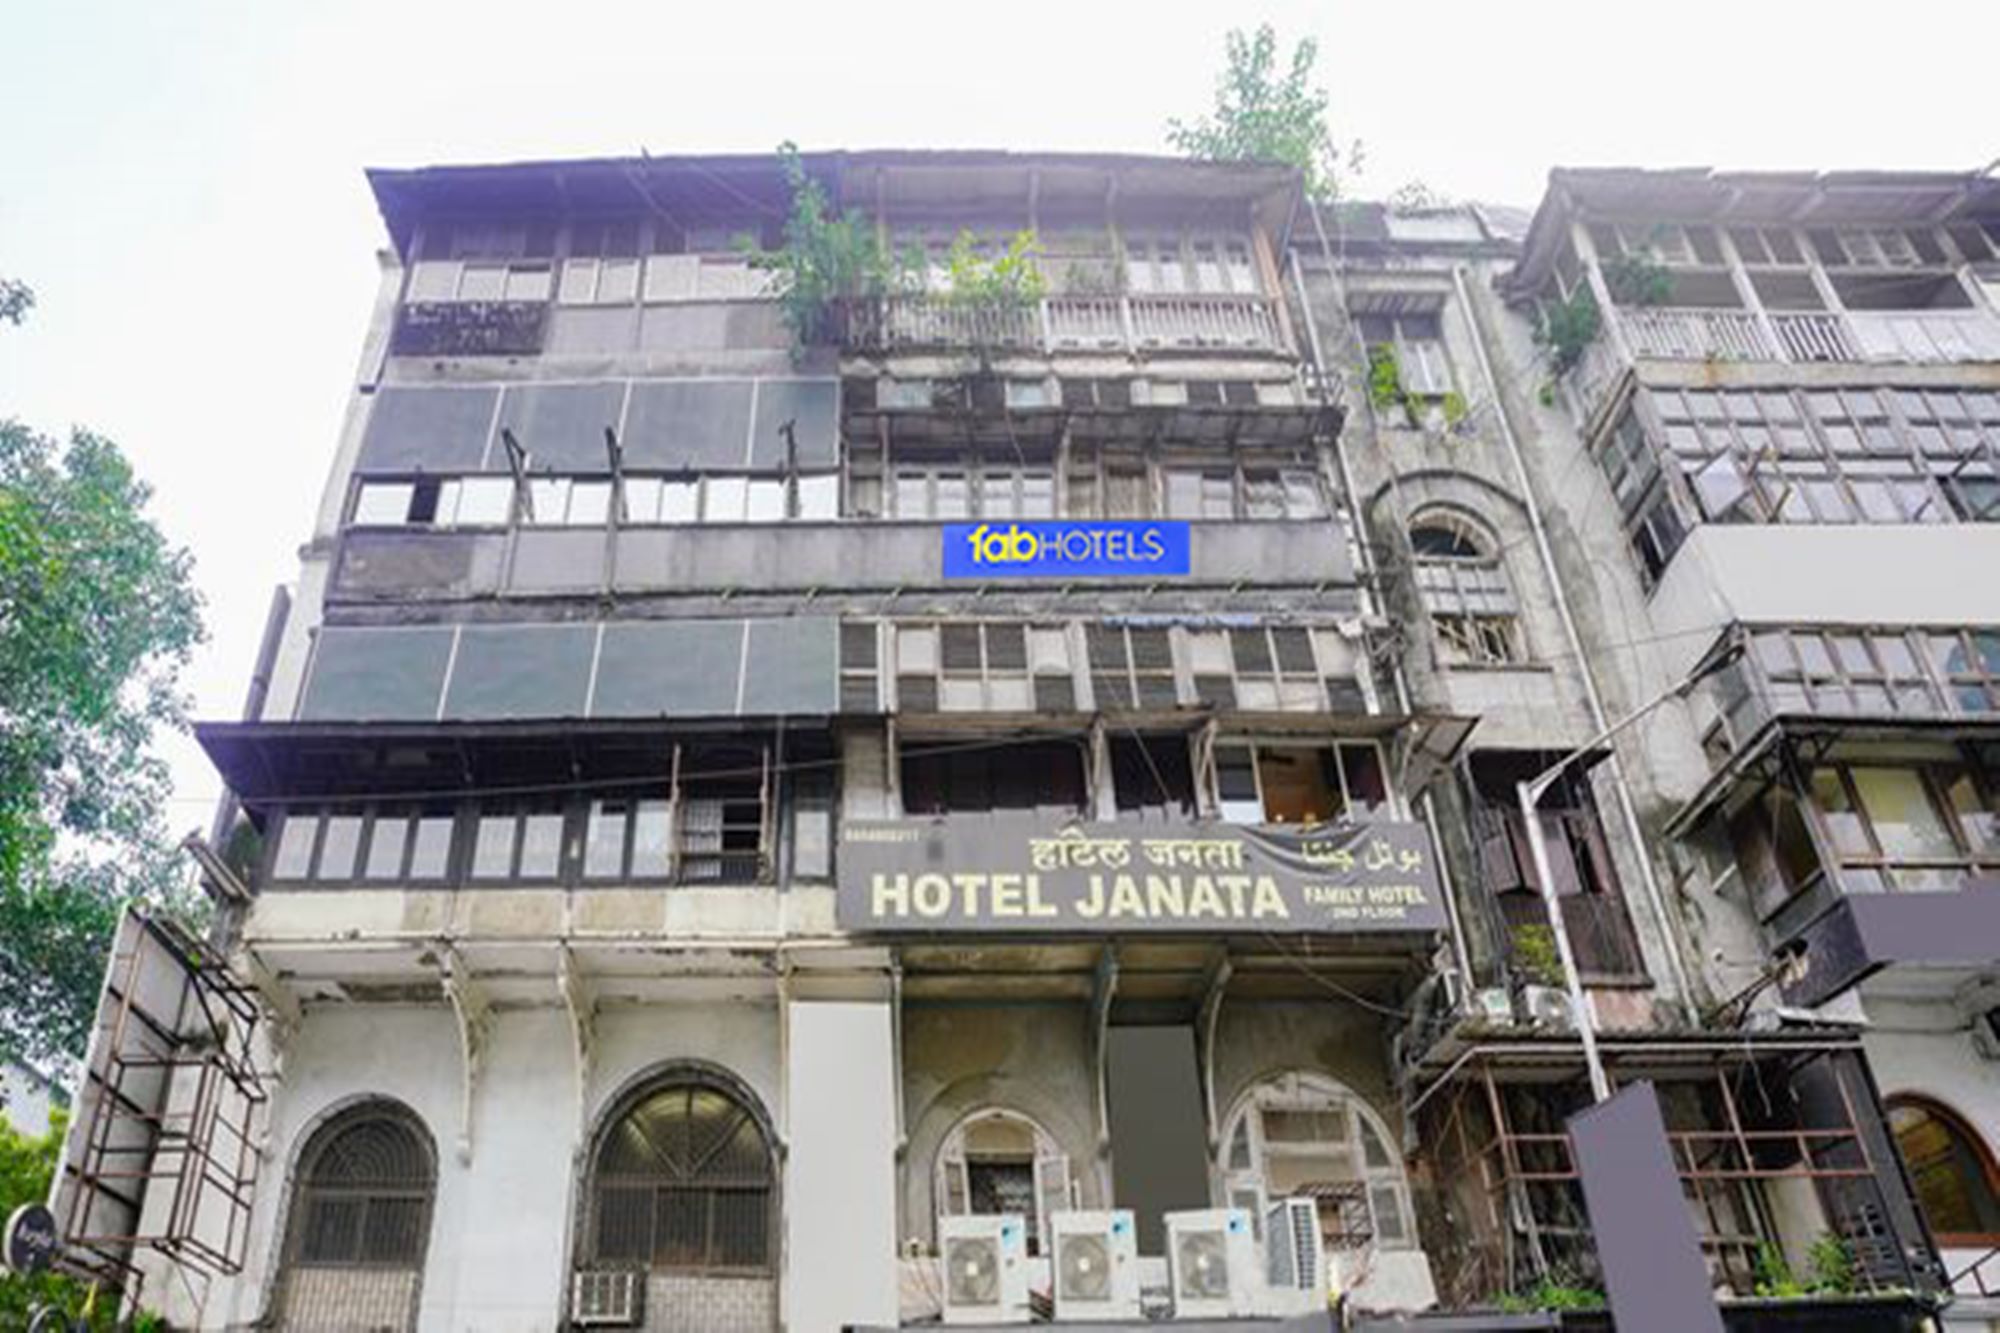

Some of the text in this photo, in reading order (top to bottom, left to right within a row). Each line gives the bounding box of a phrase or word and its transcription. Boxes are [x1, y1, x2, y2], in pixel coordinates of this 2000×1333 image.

[967, 524, 1165, 563] fabHOTELS
[1141, 839, 1243, 868] जनता
[872, 873, 1289, 918] HOTEL JANATA
[1304, 886, 1428, 905] FAMILY HOTEL
